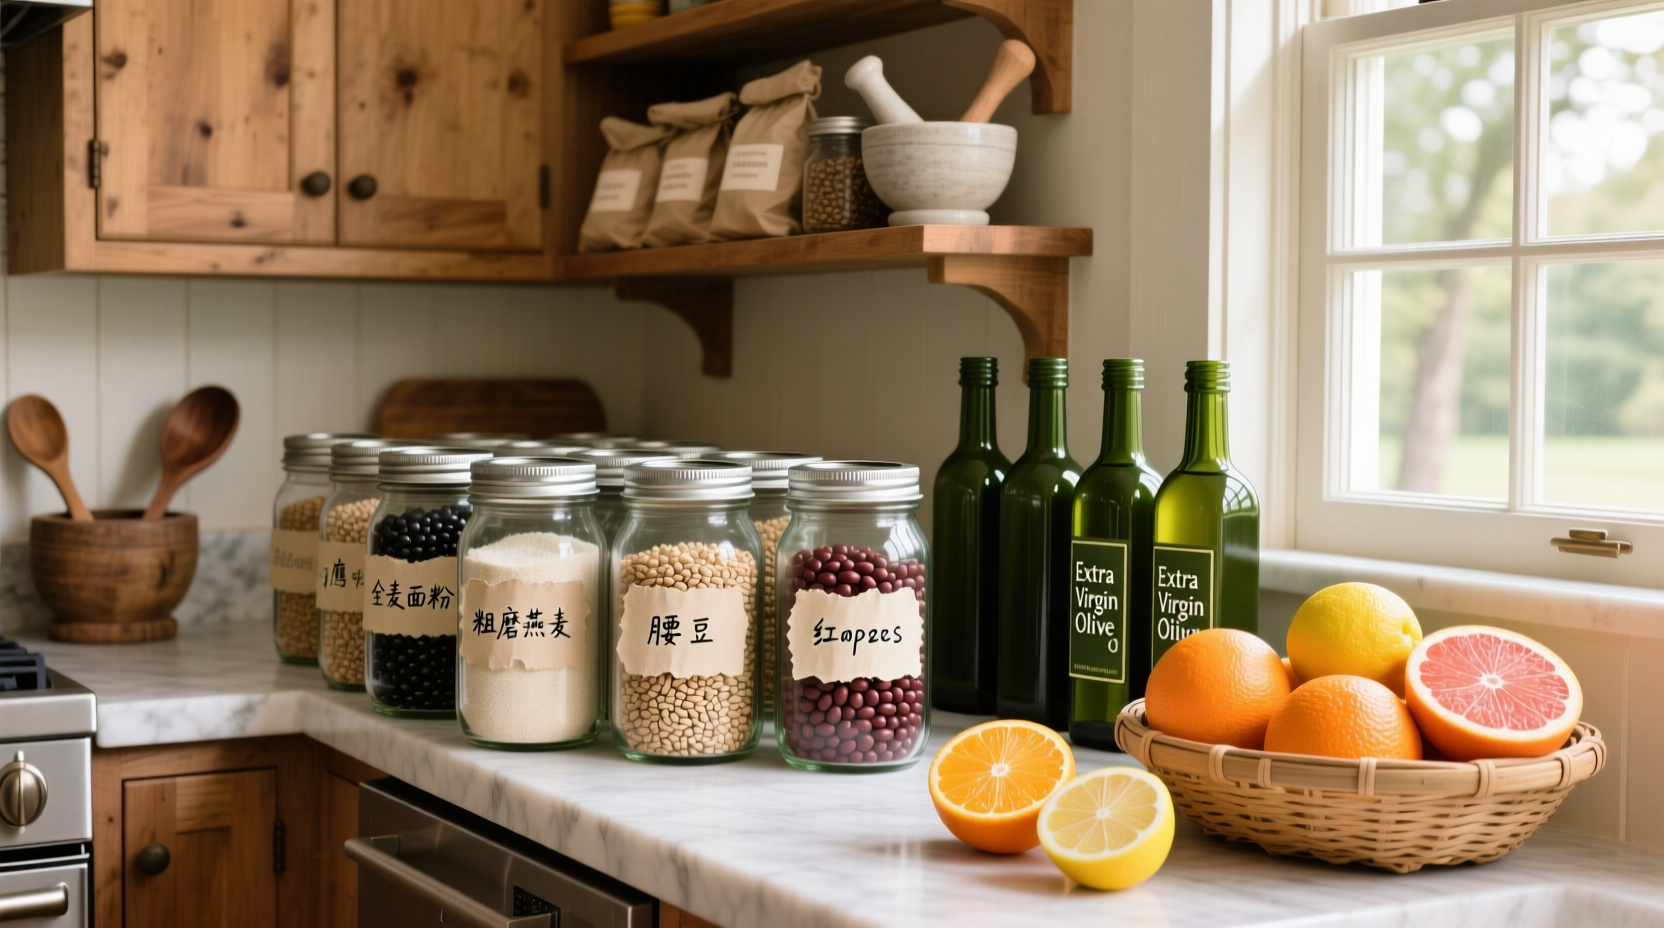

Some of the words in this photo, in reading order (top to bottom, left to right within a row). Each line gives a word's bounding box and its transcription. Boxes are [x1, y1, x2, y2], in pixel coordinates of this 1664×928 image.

[1075, 561, 1115, 585] Extra
[1157, 565, 1199, 590] Extra
[371, 578, 455, 610] 全麦面粉
[1075, 586, 1119, 616] Virgin
[1157, 590, 1205, 622] Virgin
[472, 606, 571, 640] 粗磨燕麦
[647, 614, 714, 646] 腰豆
[1075, 612, 1115, 637] Olive
